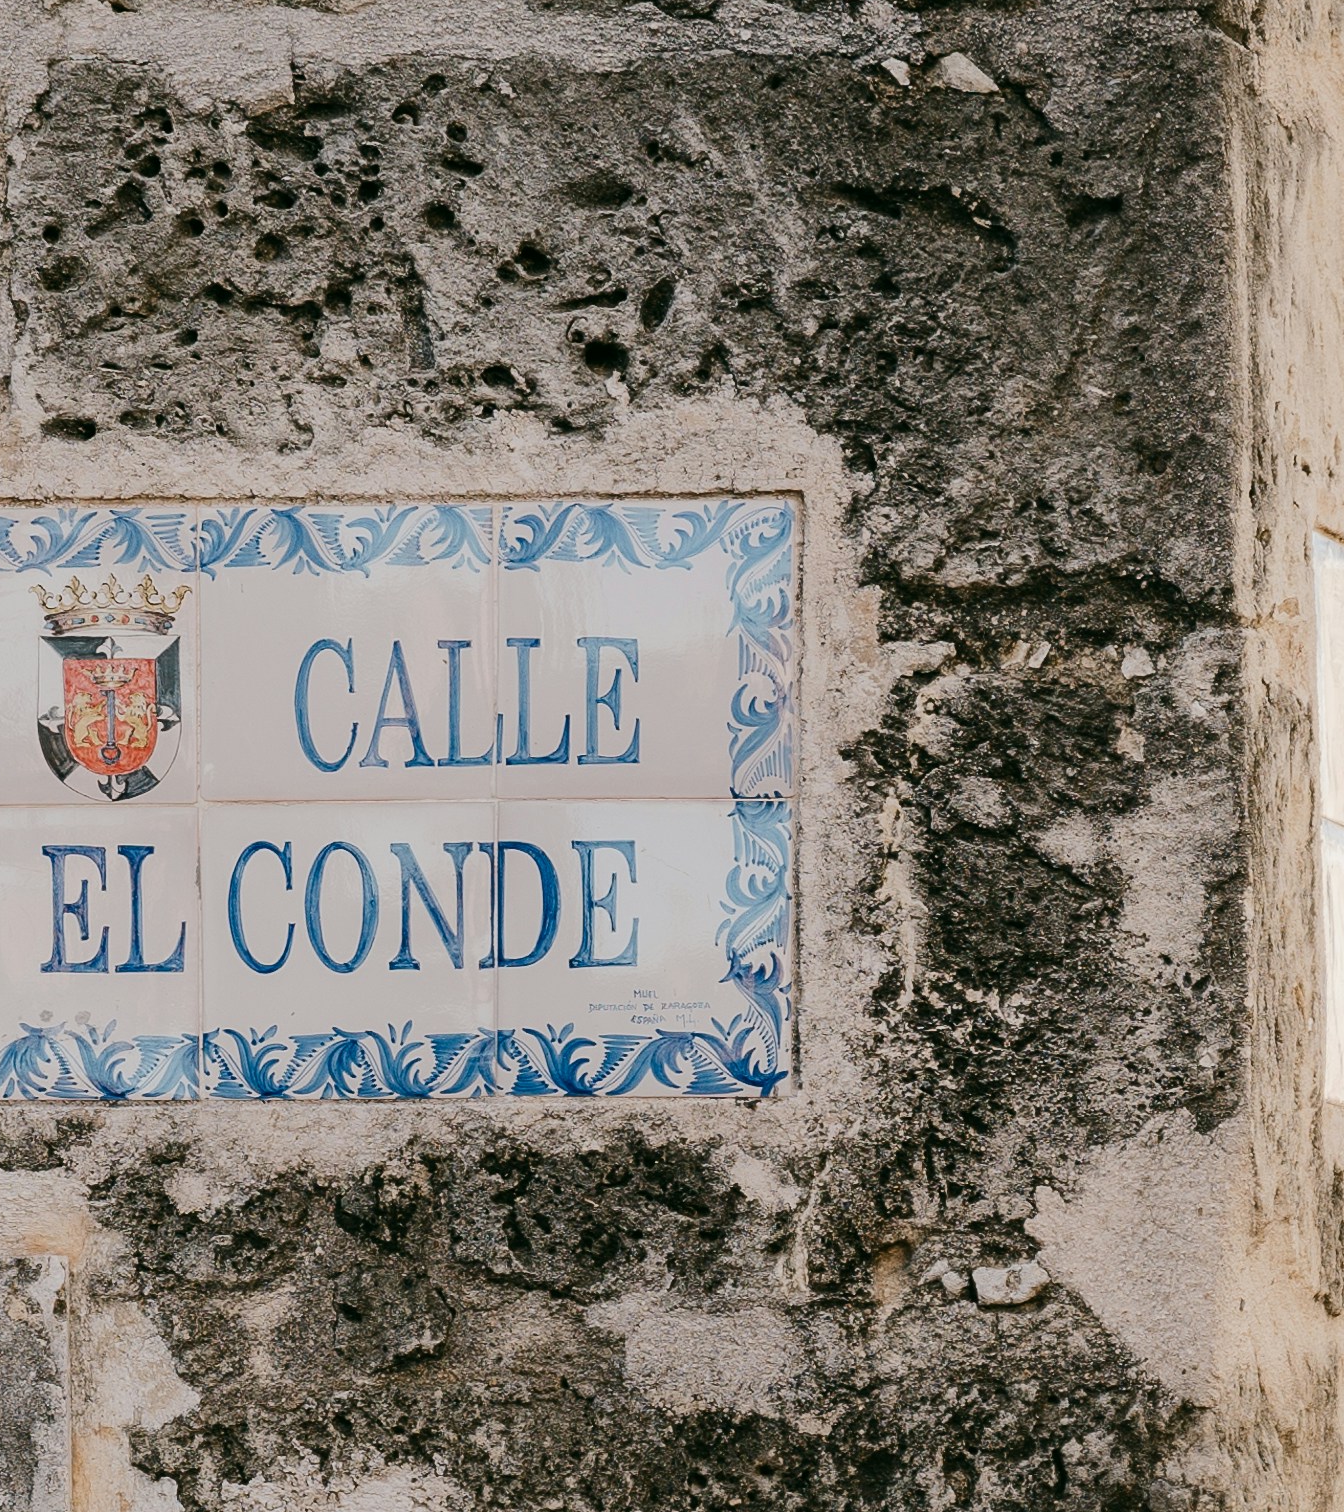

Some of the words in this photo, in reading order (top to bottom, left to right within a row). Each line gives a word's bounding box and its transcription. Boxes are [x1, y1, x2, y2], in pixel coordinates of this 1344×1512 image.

[293, 636, 641, 772] CALLE
[40, 844, 187, 975] EL
[227, 839, 640, 975] CONDE
[630, 1013, 666, 1025] ESPAÑA
[642, 1002, 654, 1011] DE
